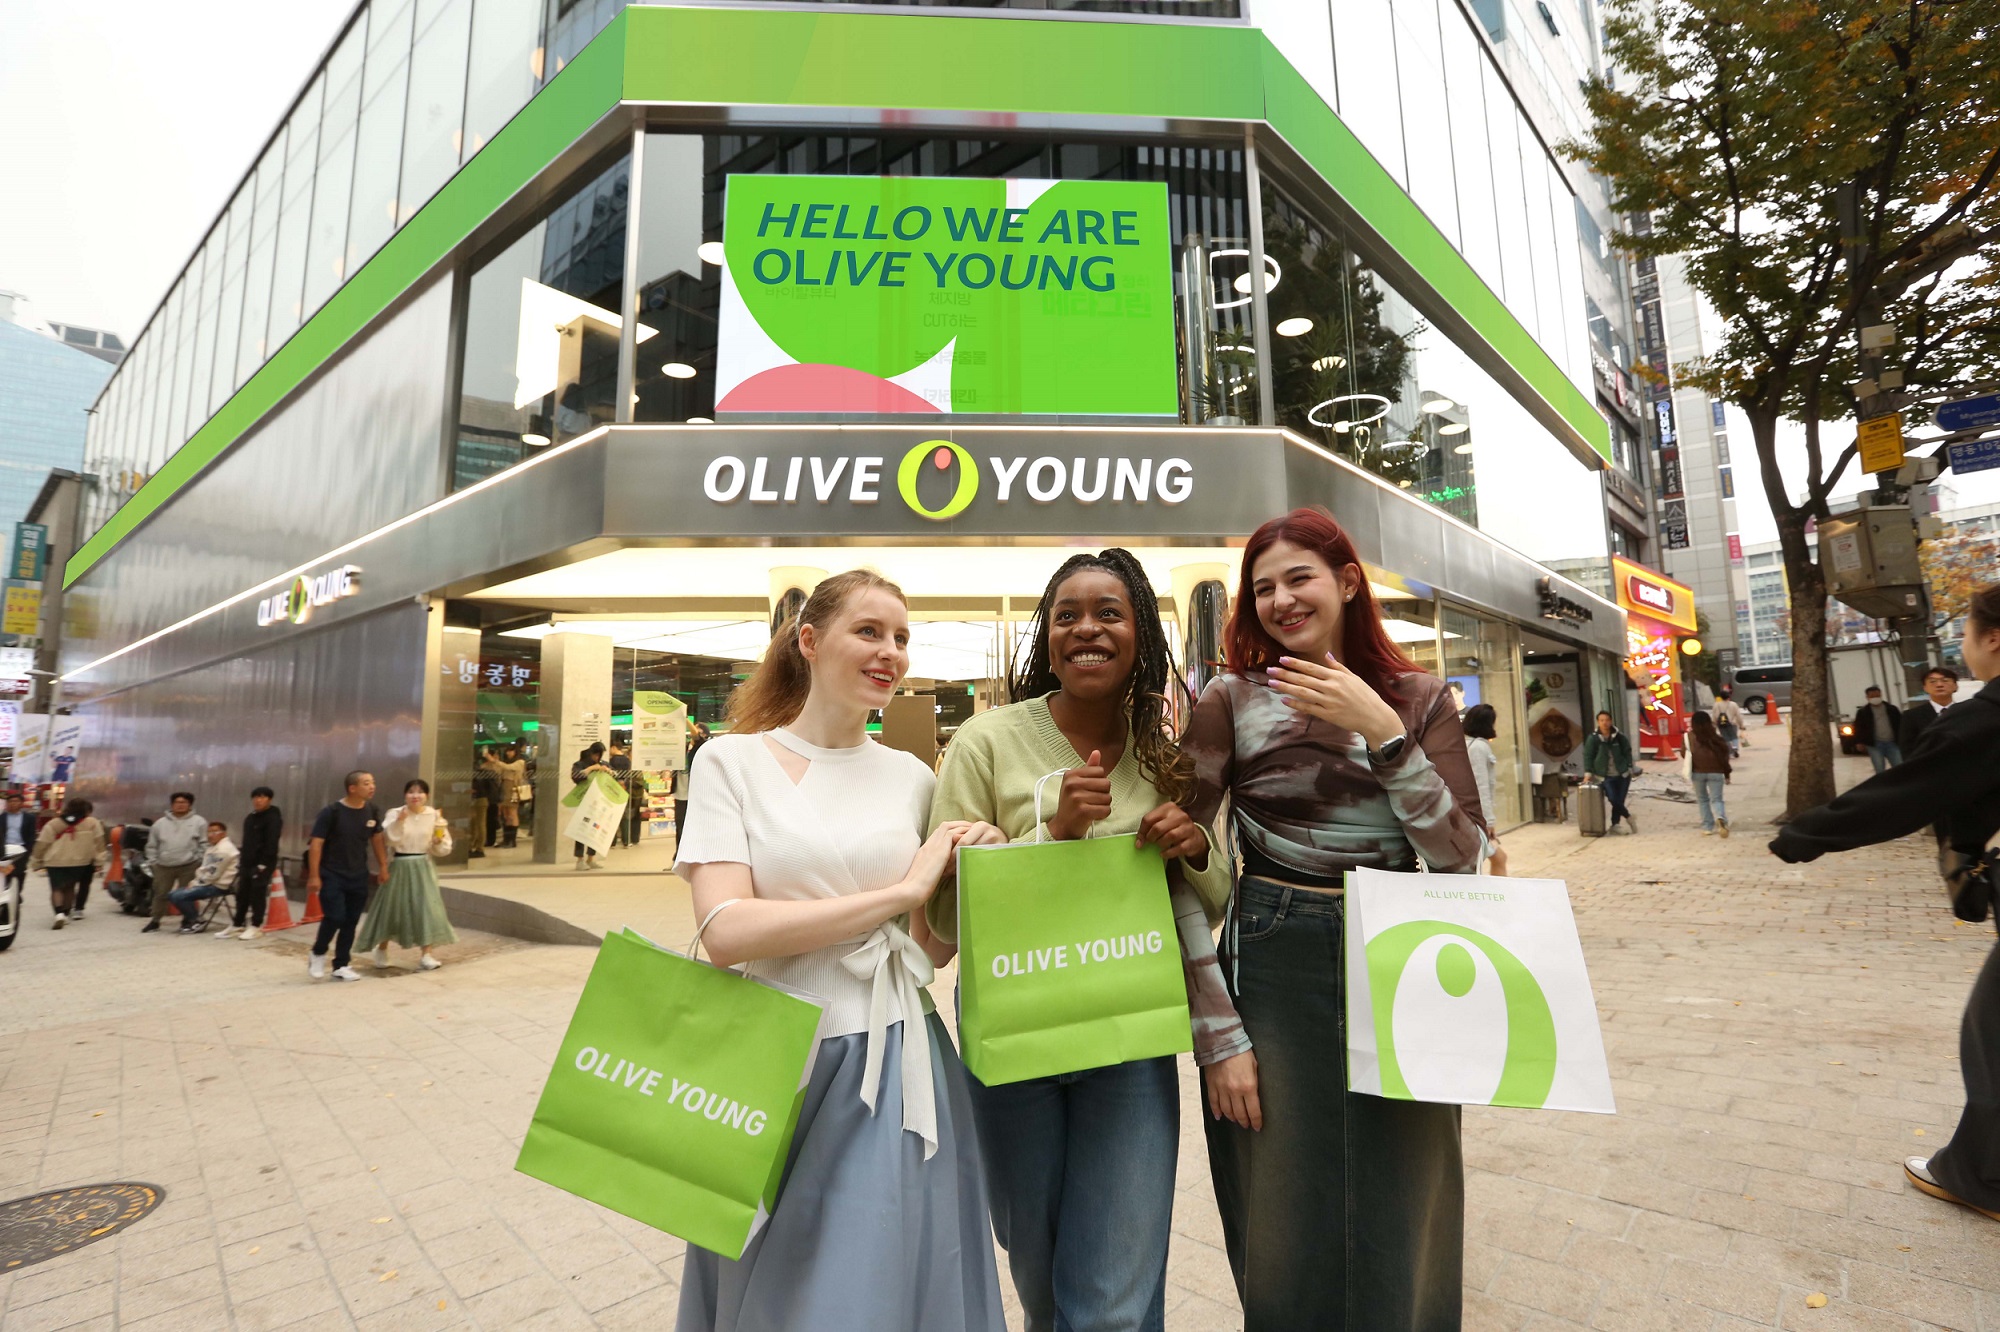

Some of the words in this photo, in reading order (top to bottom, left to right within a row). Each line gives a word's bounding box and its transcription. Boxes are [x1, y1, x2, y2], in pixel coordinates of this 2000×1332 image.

[757, 203, 931, 241] HELLO
[943, 207, 1030, 243] WE
[1037, 210, 1139, 246] ARE
[753, 248, 911, 288] OLIVE
[924, 252, 1115, 292] YOUNG
[929, 291, 971, 306] 체지방
[1042, 292, 1151, 318] 메타그린
[923, 313, 977, 328] CUT하는
[703, 455, 884, 504] OLIVE
[989, 457, 1194, 504] YOUNG
[1424, 890, 1442, 899] ALL
[1443, 891, 1465, 900] LIVE
[1468, 892, 1506, 902] BETTER
[992, 945, 1068, 978] OLIVE
[1075, 931, 1163, 965] YOUNG
[575, 1046, 662, 1096] OLIVE
[667, 1078, 768, 1137] YOUNG
